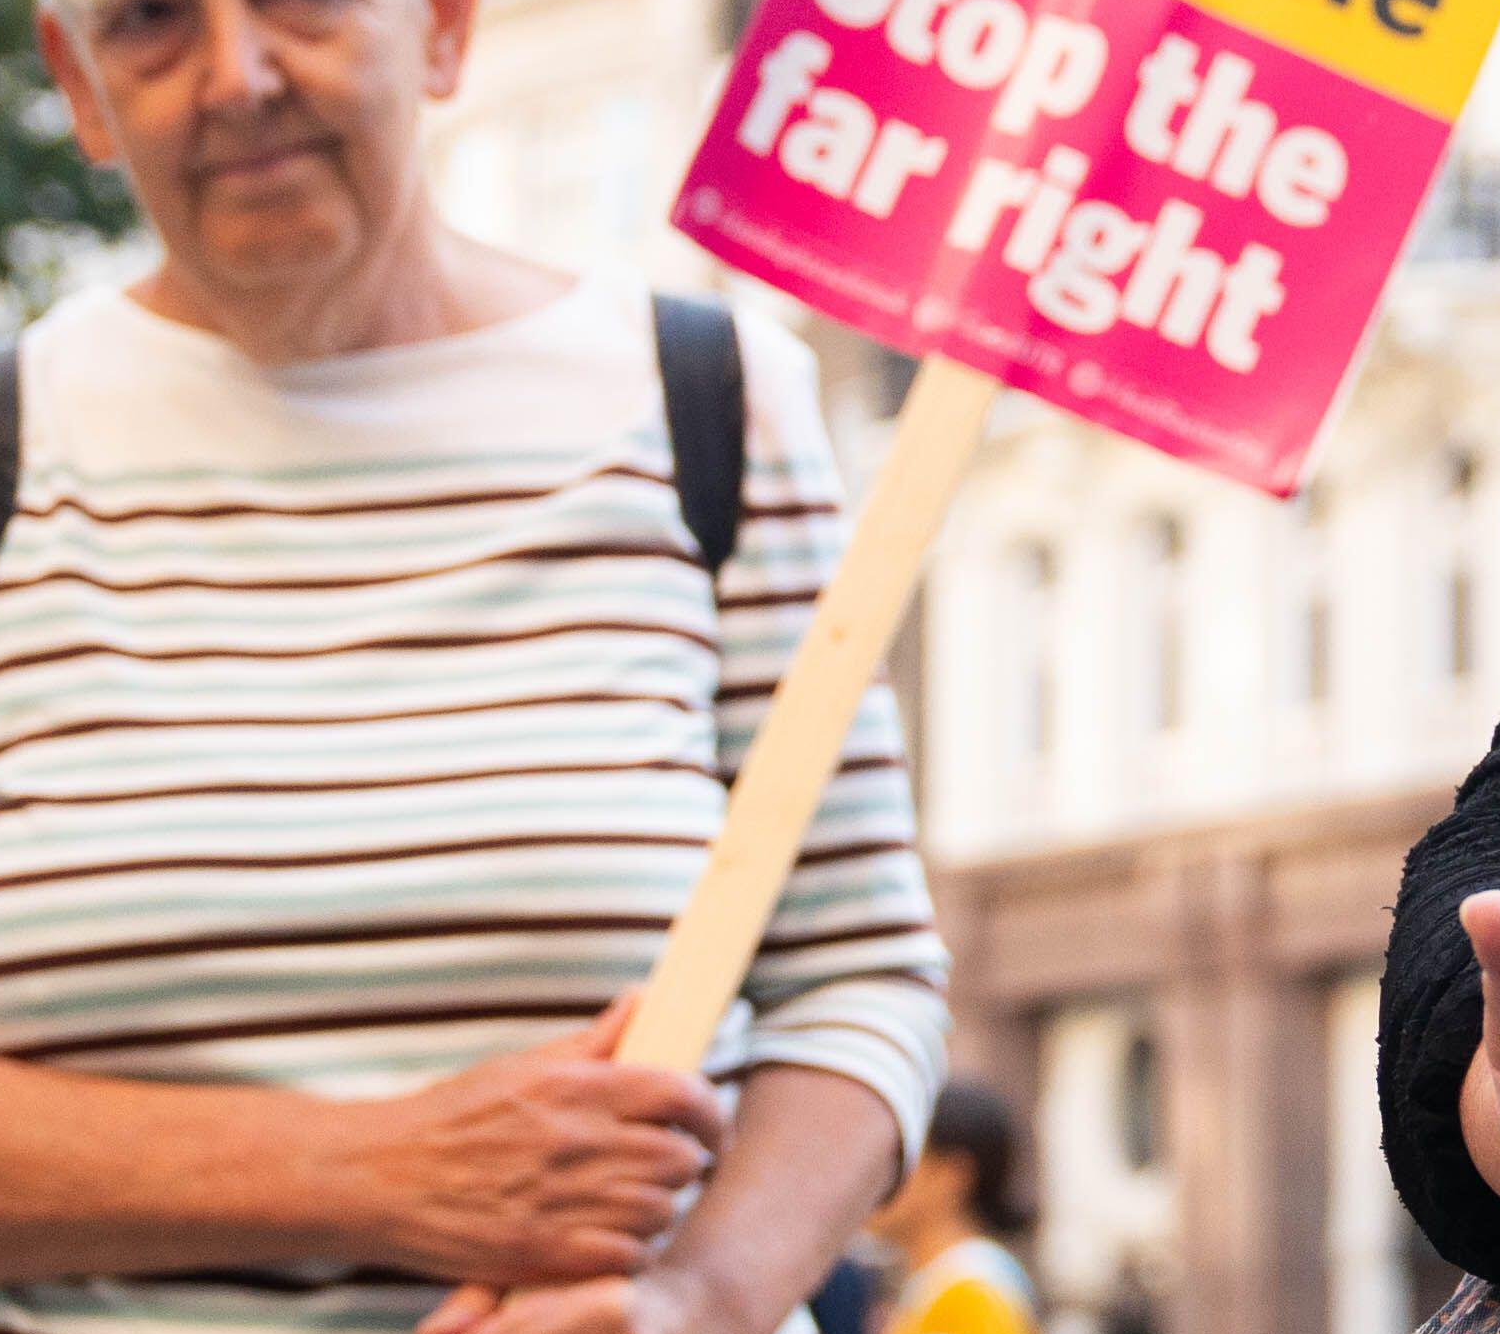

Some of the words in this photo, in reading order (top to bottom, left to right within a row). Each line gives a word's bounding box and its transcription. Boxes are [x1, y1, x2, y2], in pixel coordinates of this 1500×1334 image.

[734, 33, 948, 221] far
[945, 145, 1286, 375] right
[1122, 30, 1350, 229] the
